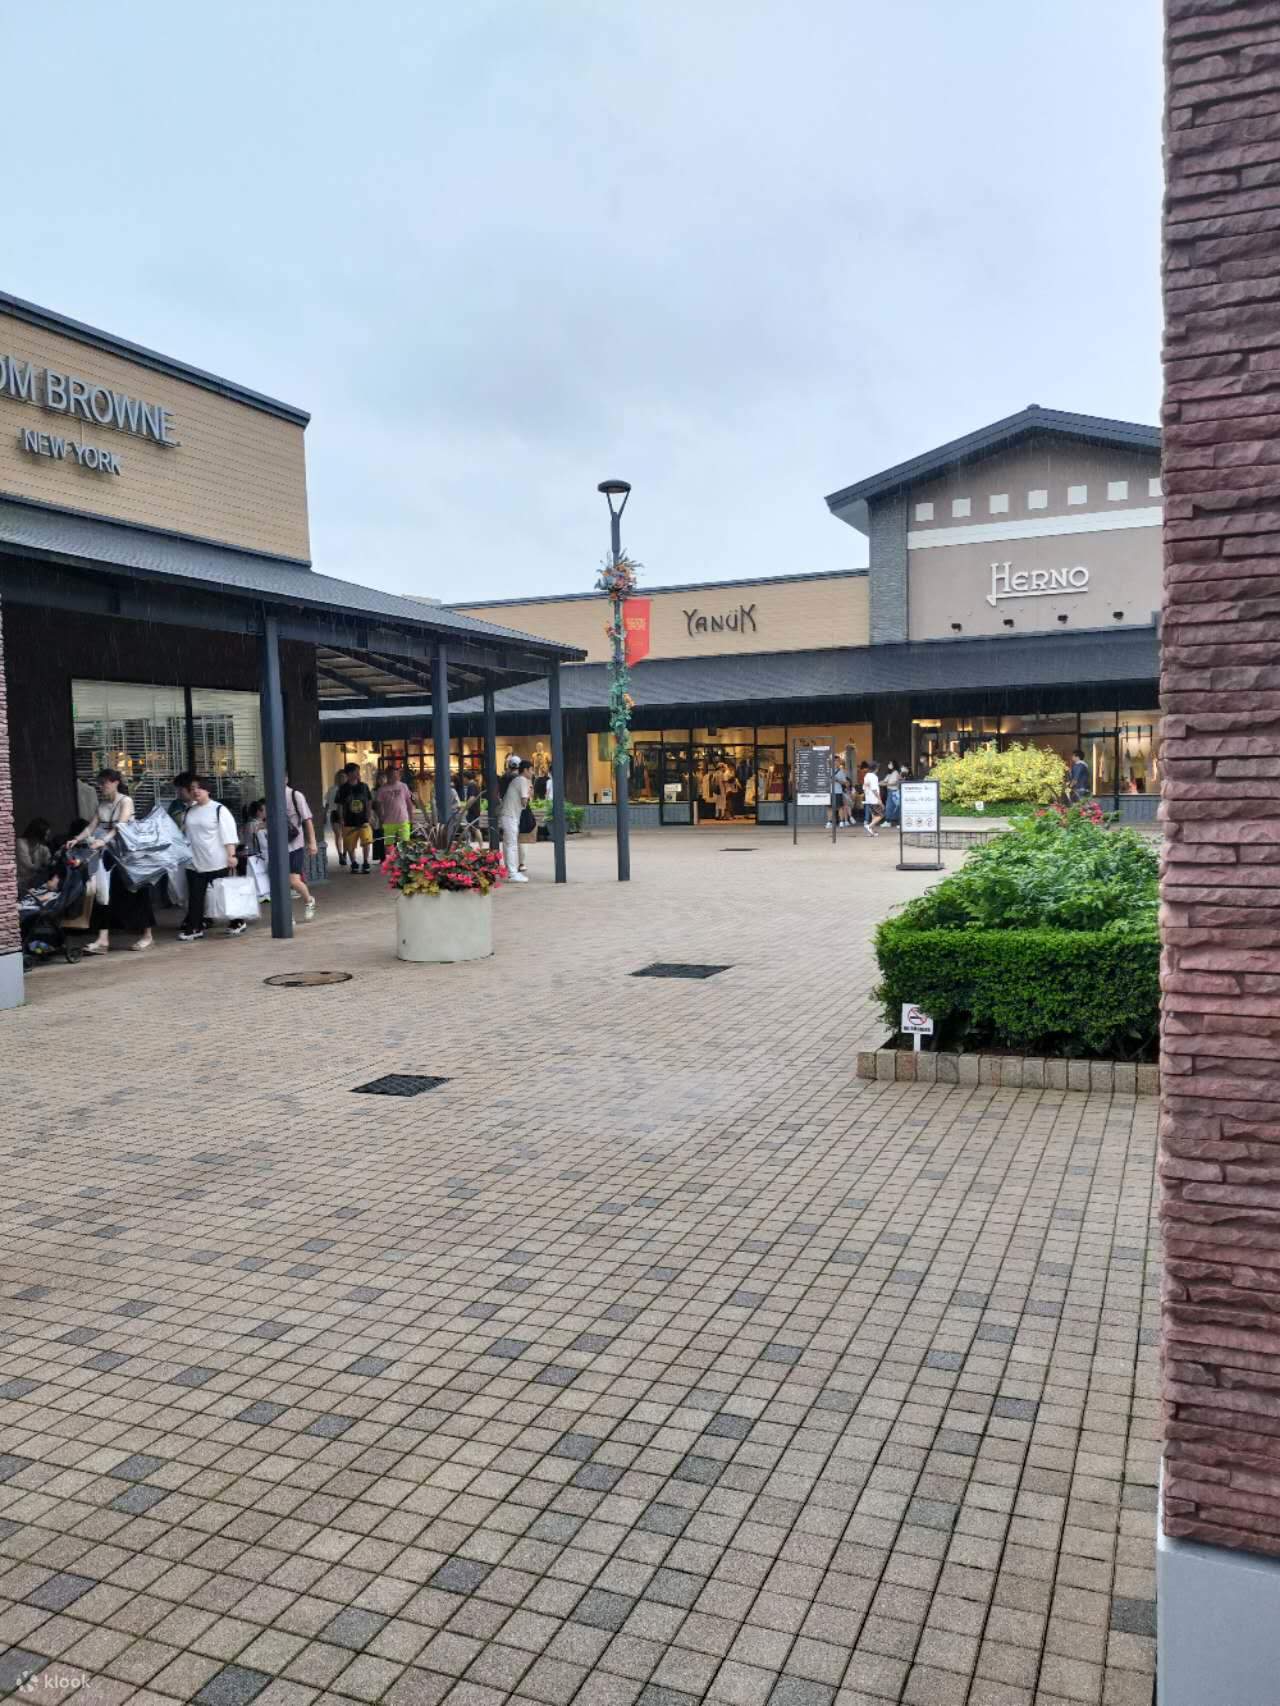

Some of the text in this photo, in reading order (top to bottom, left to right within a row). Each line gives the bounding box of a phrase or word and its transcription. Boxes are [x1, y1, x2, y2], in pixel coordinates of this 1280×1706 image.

[0, 355, 36, 402] M
[24, 429, 121, 476] NEW YORK
[987, 562, 1089, 607] HERNO
